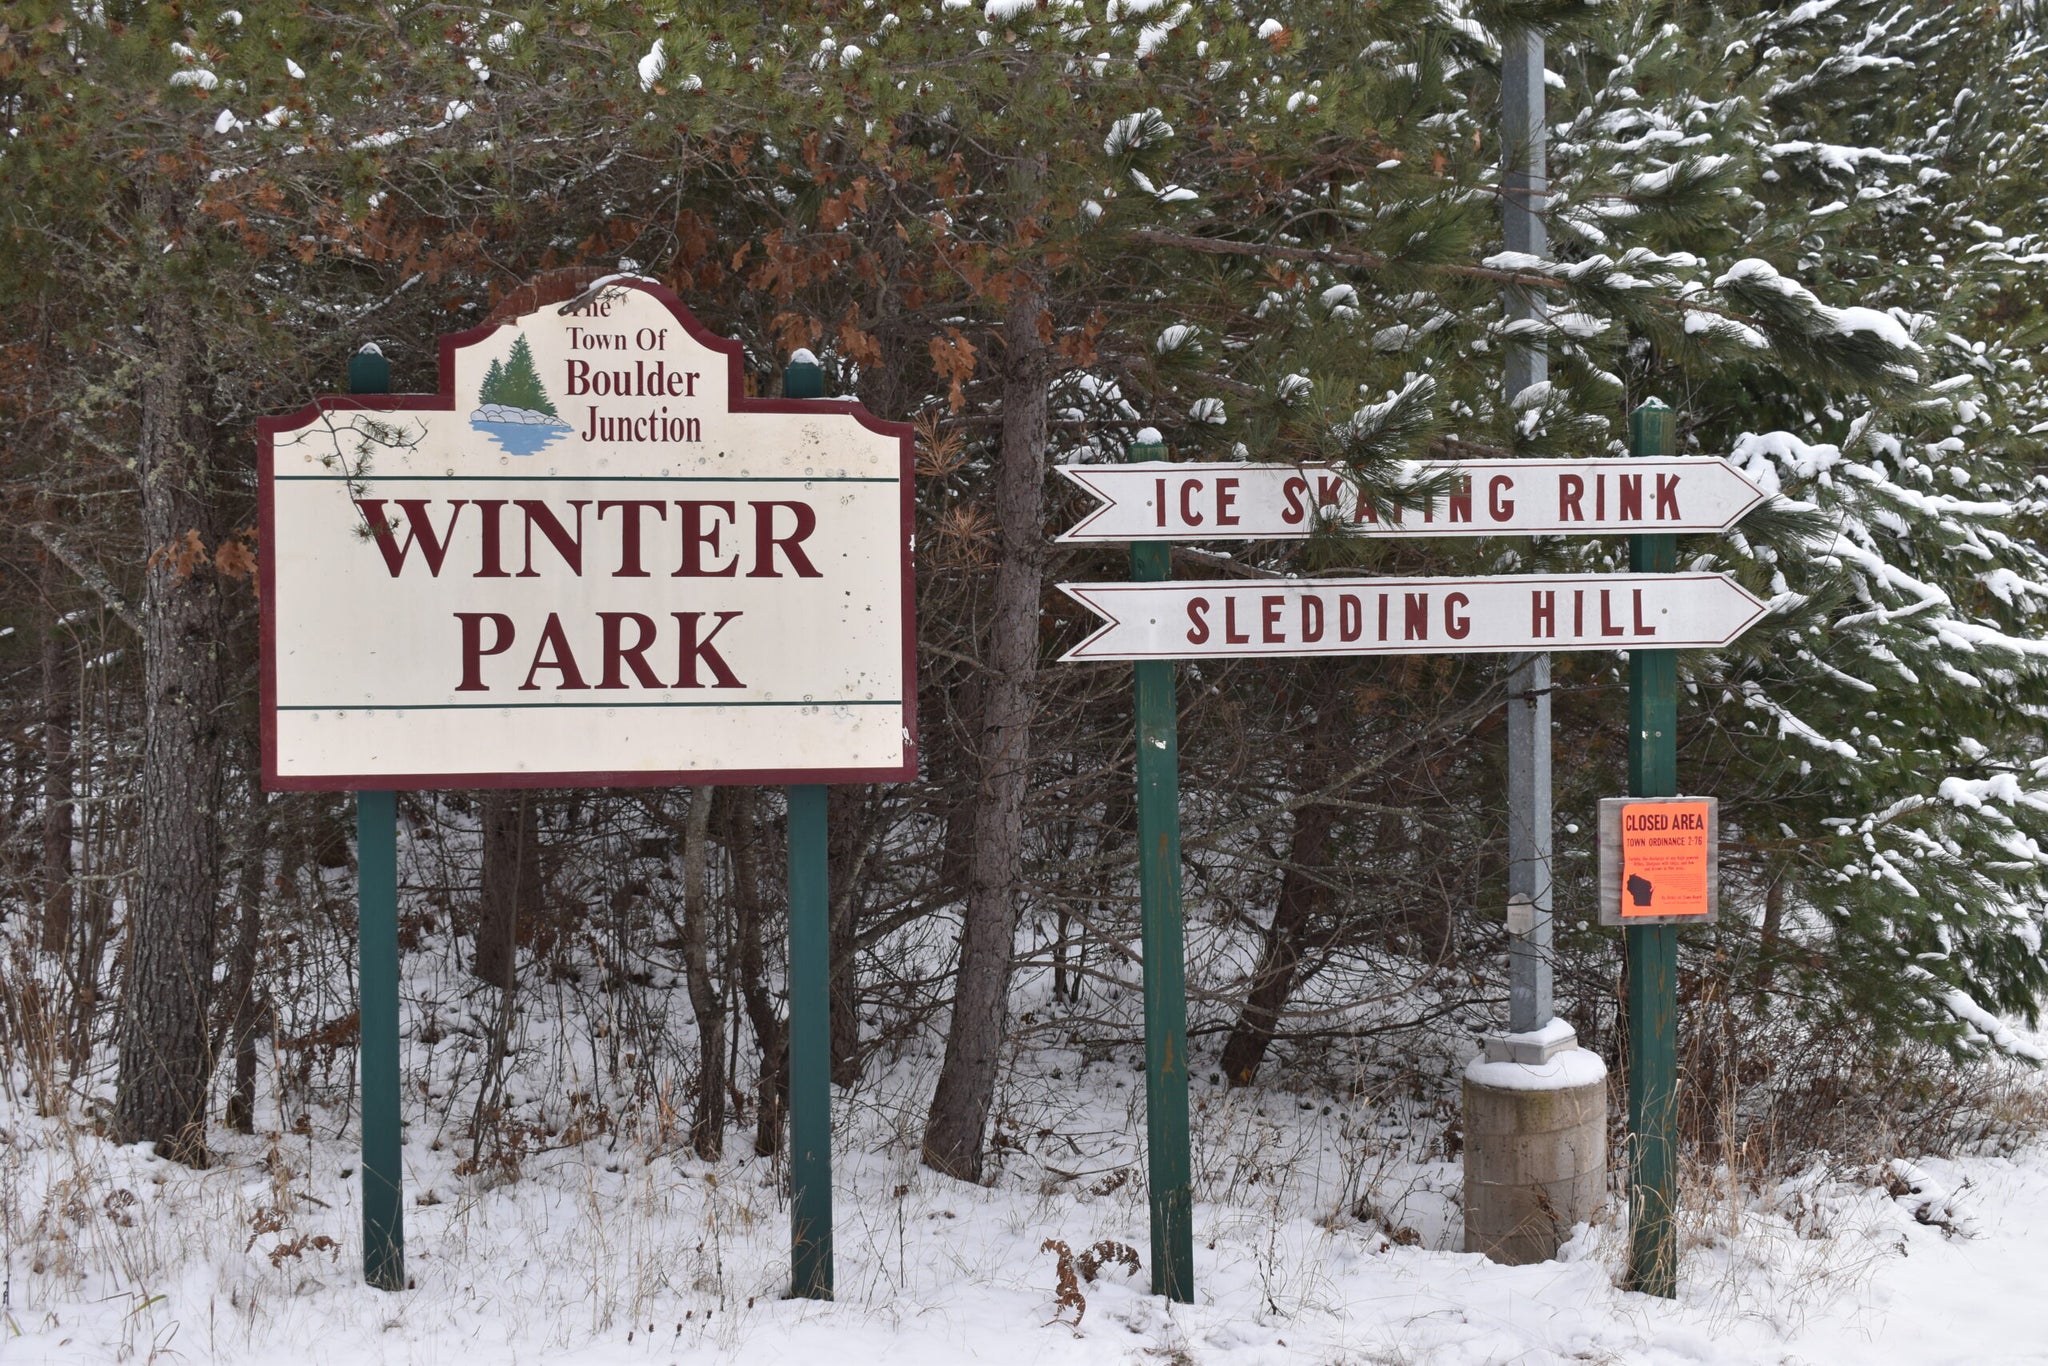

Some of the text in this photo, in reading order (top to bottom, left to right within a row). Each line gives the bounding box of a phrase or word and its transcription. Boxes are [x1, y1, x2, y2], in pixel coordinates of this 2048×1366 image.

[569, 296, 611, 317] he
[566, 327, 667, 351] Town Of
[564, 359, 700, 397] Boulder
[582, 406, 702, 443] Junction
[1155, 477, 1240, 528] ICE
[1559, 473, 1682, 521] RINK
[355, 499, 824, 578] WINTER
[1186, 589, 1656, 645] SLEDDING HILL
[453, 611, 747, 692] PARK
[1626, 813, 1704, 831] CLOSED AREA
[1627, 838, 1646, 847] TOWN
[1649, 836, 1685, 847] ORDINANCE
